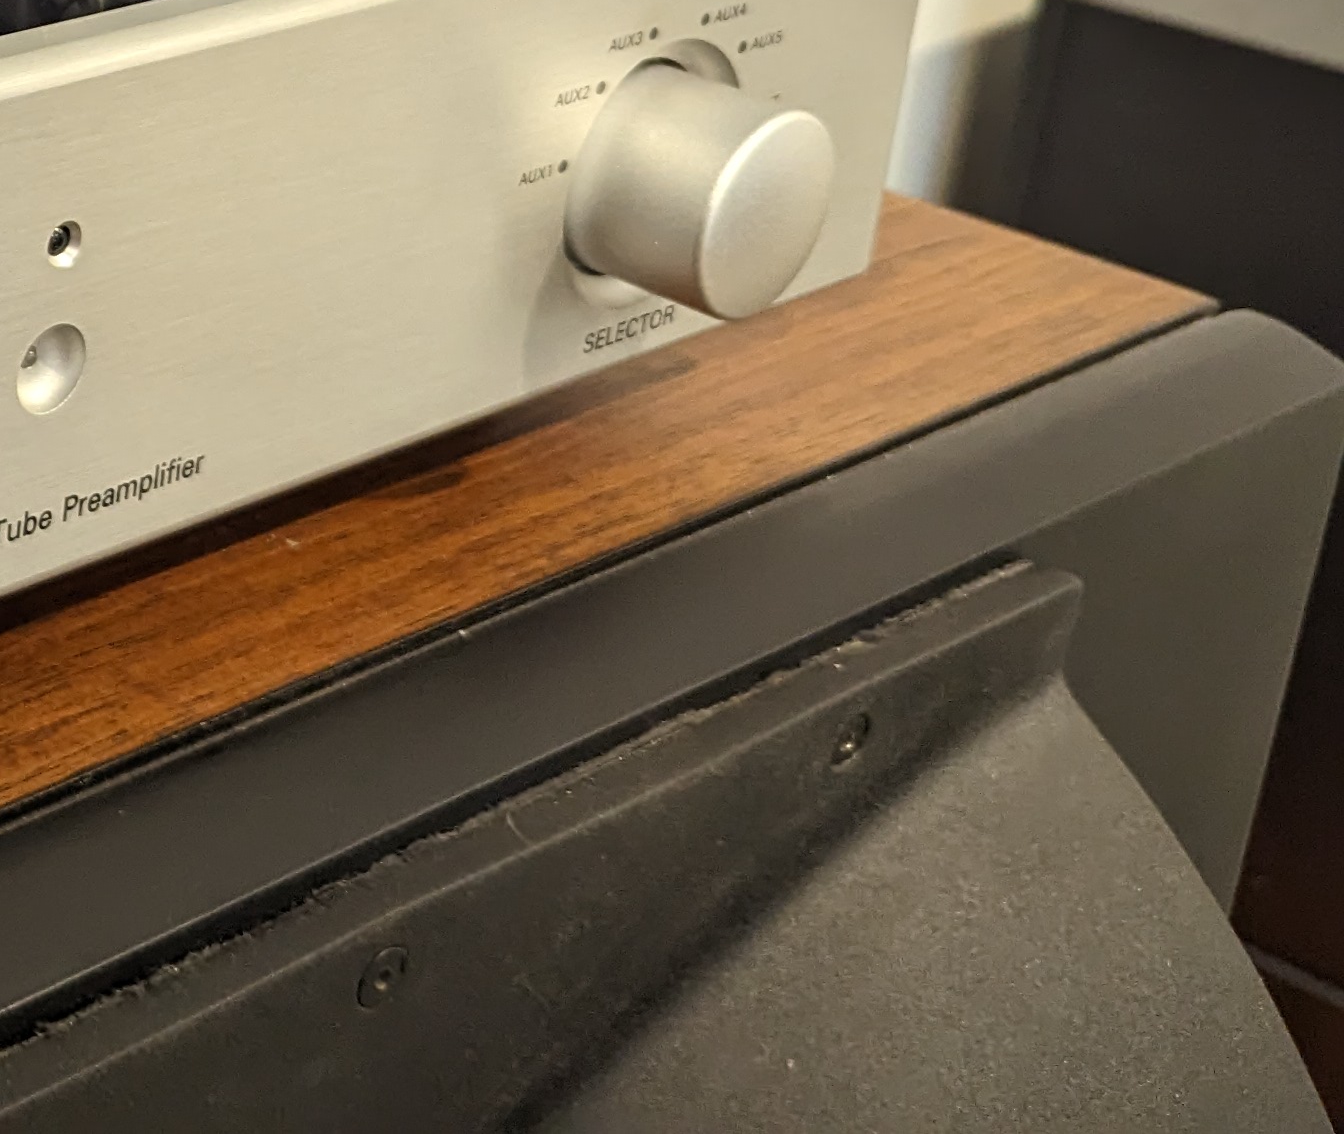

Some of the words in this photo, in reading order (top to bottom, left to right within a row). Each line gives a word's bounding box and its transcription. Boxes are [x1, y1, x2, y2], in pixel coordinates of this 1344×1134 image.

[713, 2, 748, 24] AUX4
[609, 31, 643, 53] AUX3
[750, 29, 784, 51] AUX5
[555, 85, 590, 107] AUX2
[518, 164, 553, 186] AUX1
[583, 304, 676, 354] SELECTOR
[62, 453, 205, 522] Preamplifier
